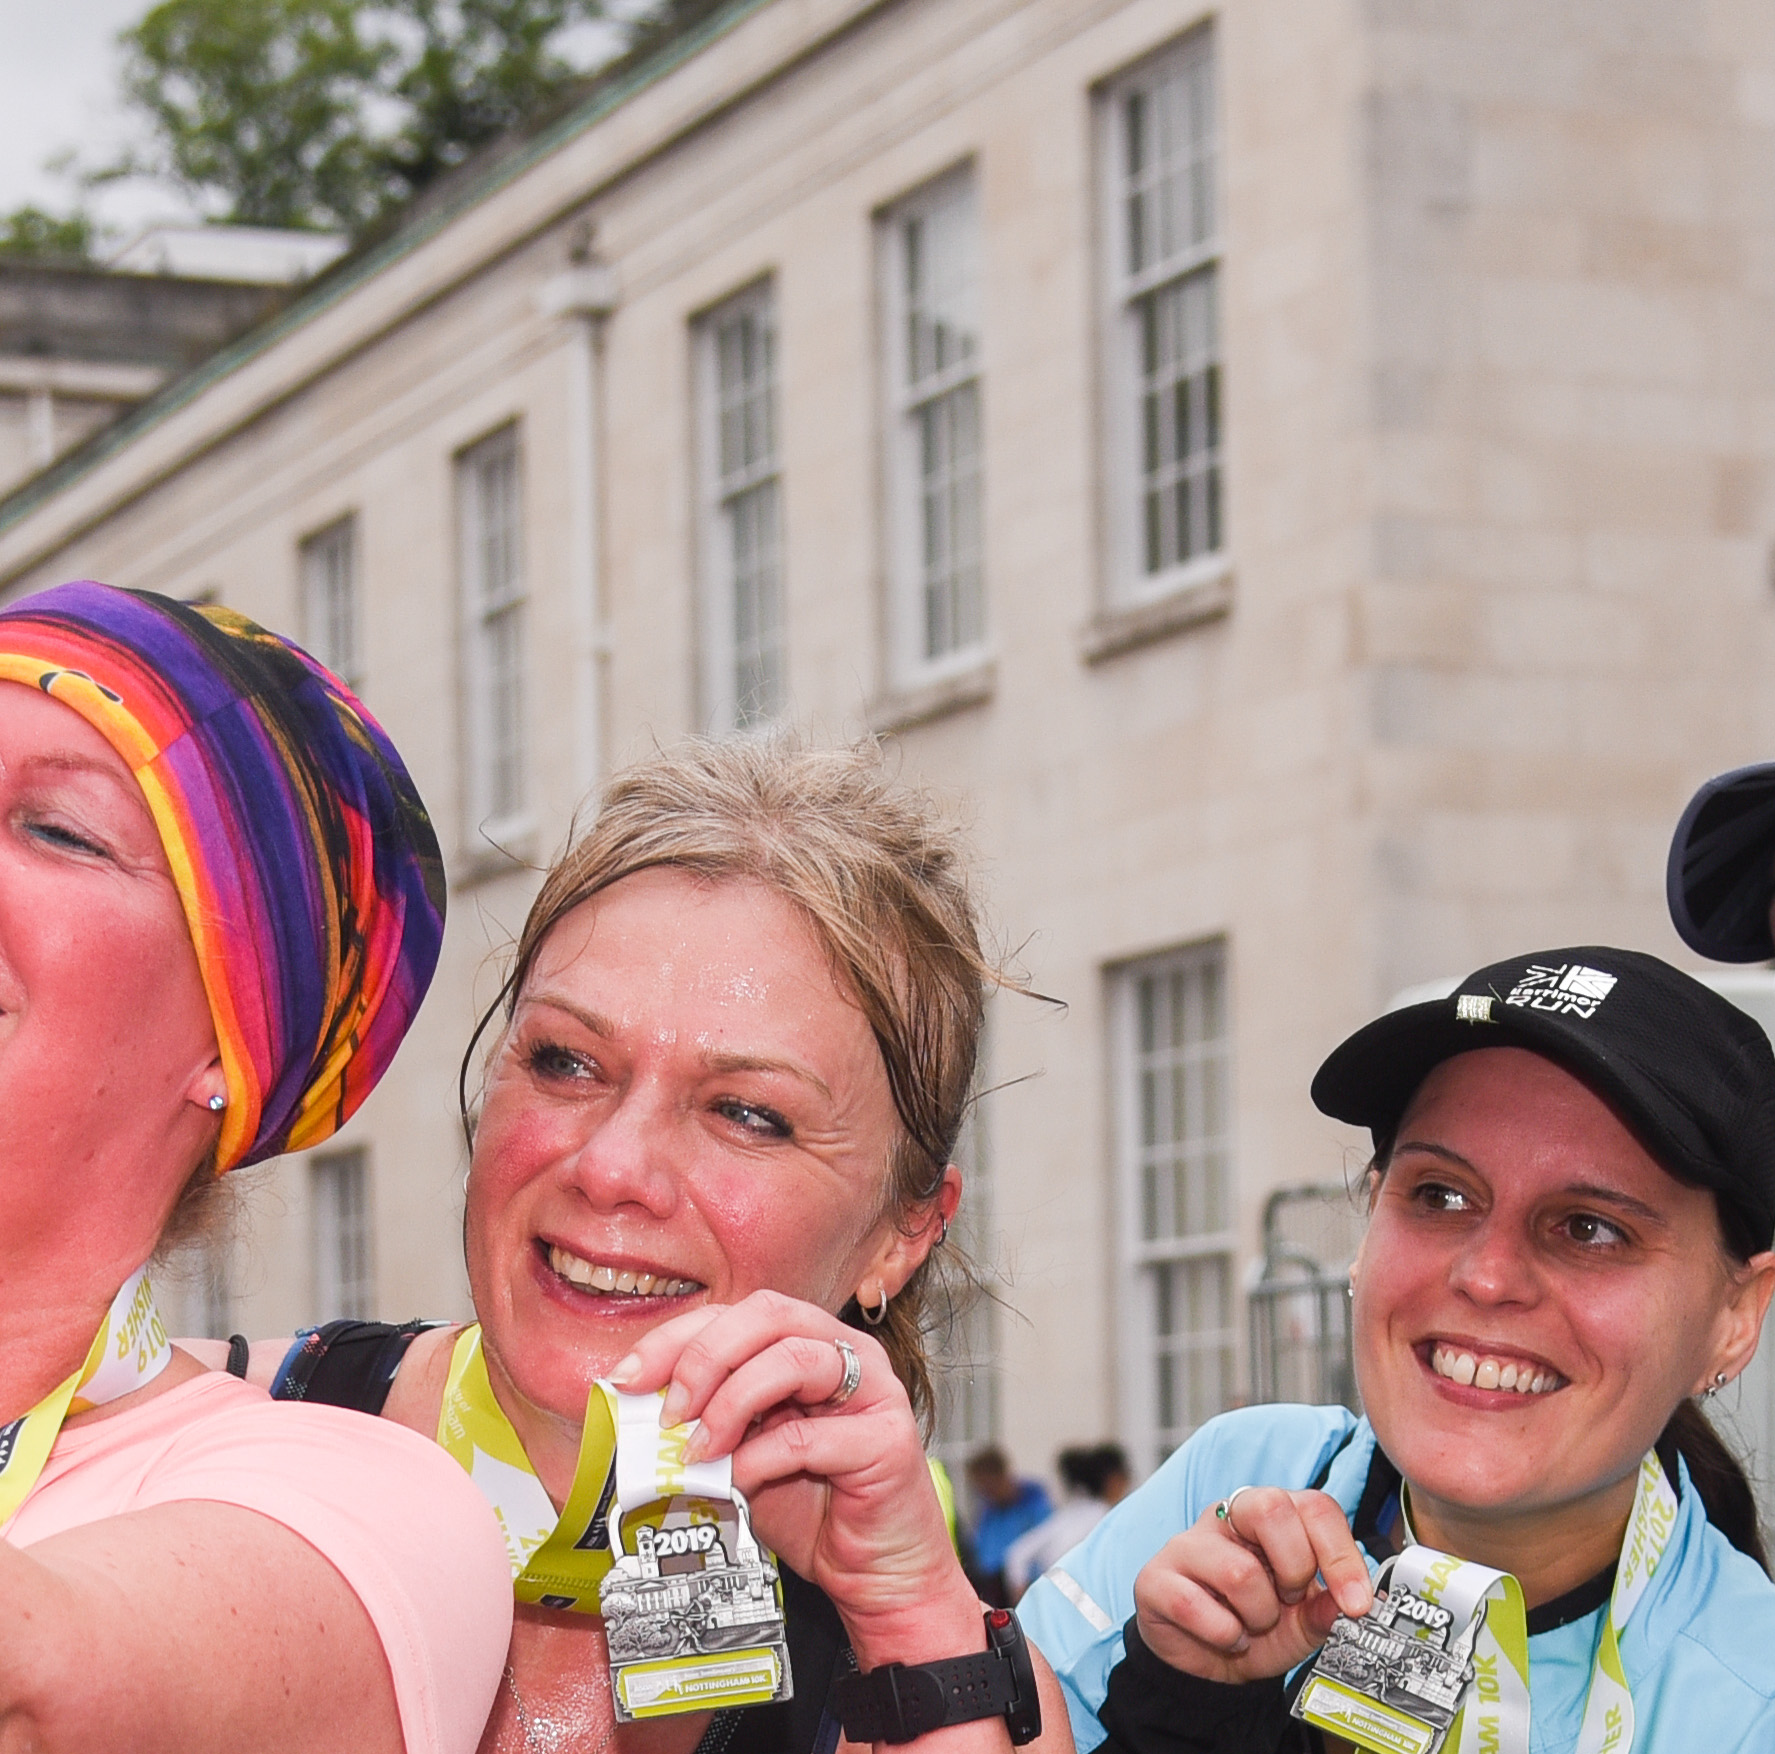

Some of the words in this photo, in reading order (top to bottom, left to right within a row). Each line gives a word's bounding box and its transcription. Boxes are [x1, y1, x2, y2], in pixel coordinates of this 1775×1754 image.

[1505, 996, 1596, 1019] RUN
[116, 1274, 152, 1360] NISHER
[654, 1526, 717, 1555] 2019
[1399, 1594, 1451, 1628] 2019
[685, 1678, 750, 1693] NOTTINGHAM
[751, 1675, 767, 1684] 10K
[1477, 1654, 1500, 1703] 10K
[1352, 1717, 1402, 1743] NOTTINGHAM
